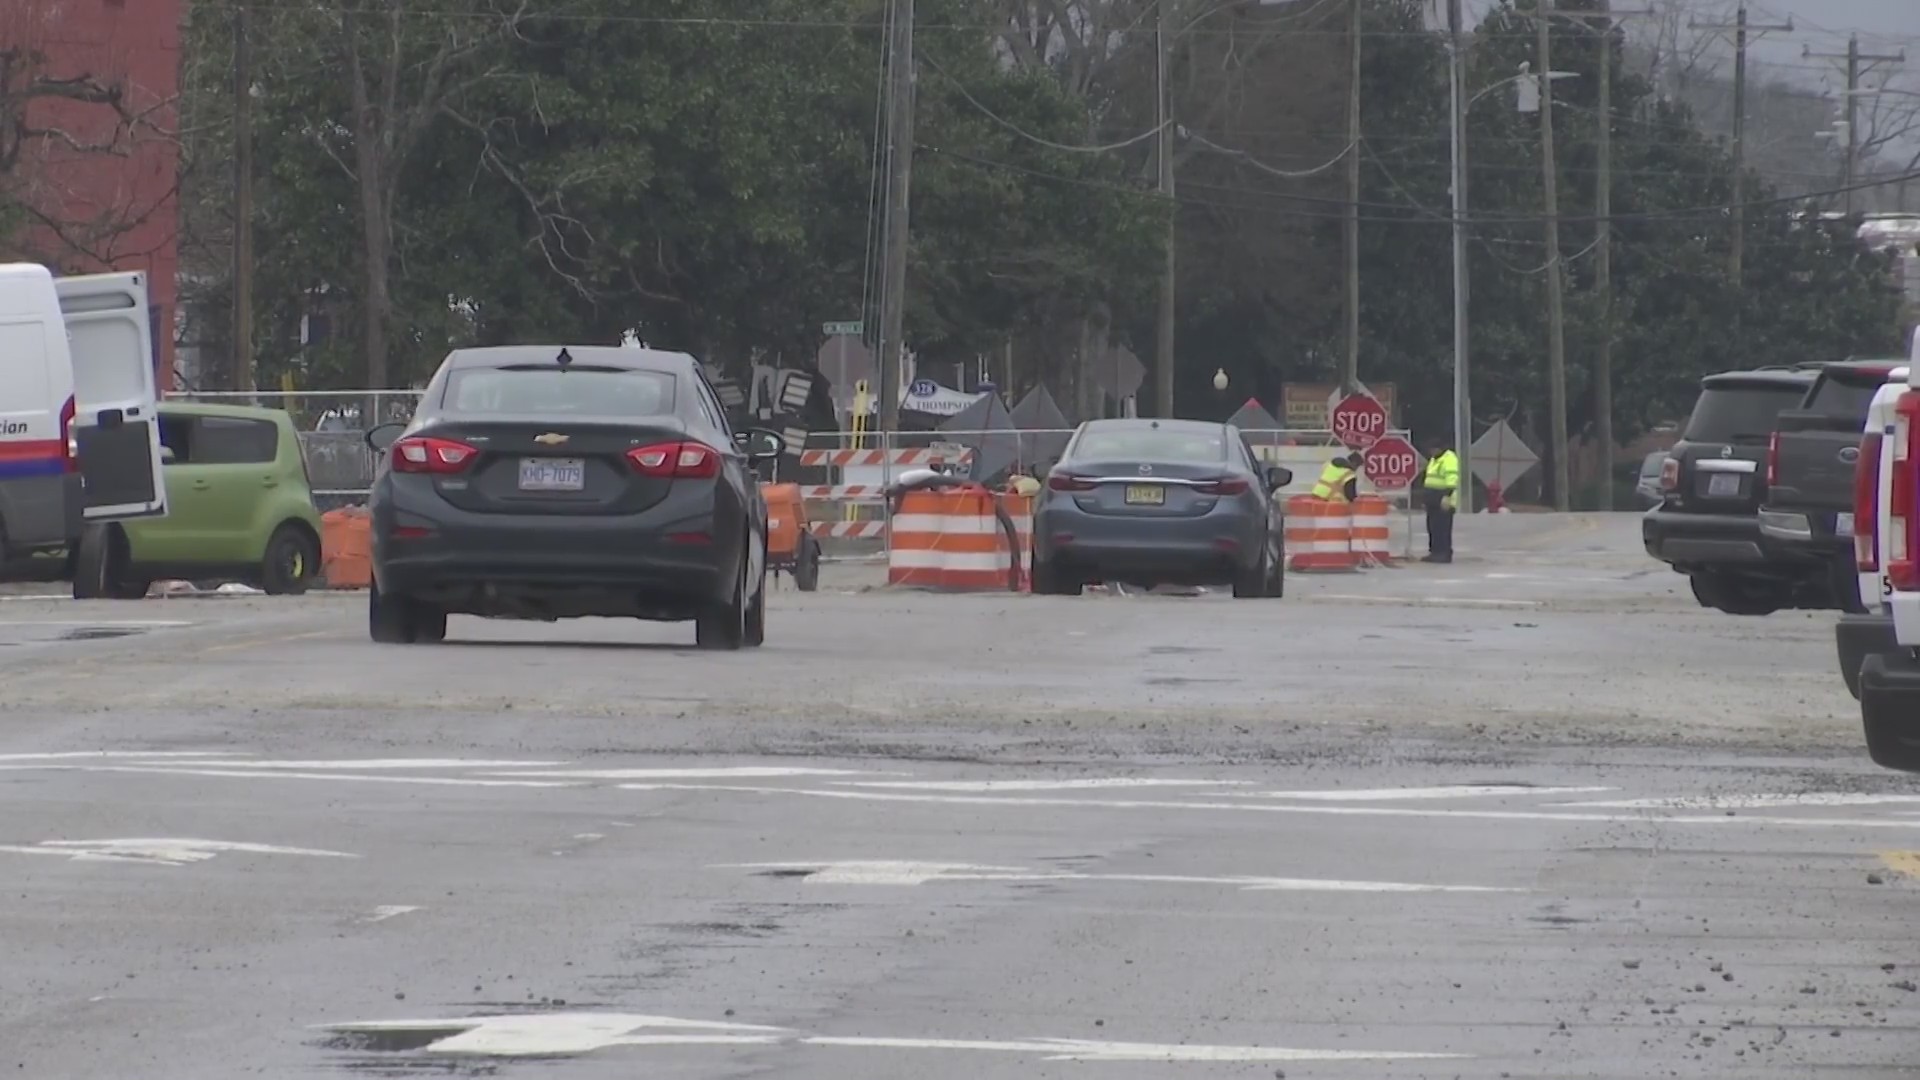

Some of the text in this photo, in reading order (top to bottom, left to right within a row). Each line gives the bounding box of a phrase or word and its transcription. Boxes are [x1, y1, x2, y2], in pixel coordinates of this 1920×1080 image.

[0, 420, 28, 434] ian
[1335, 411, 1383, 432] STOP
[1367, 454, 1413, 474] STOP
